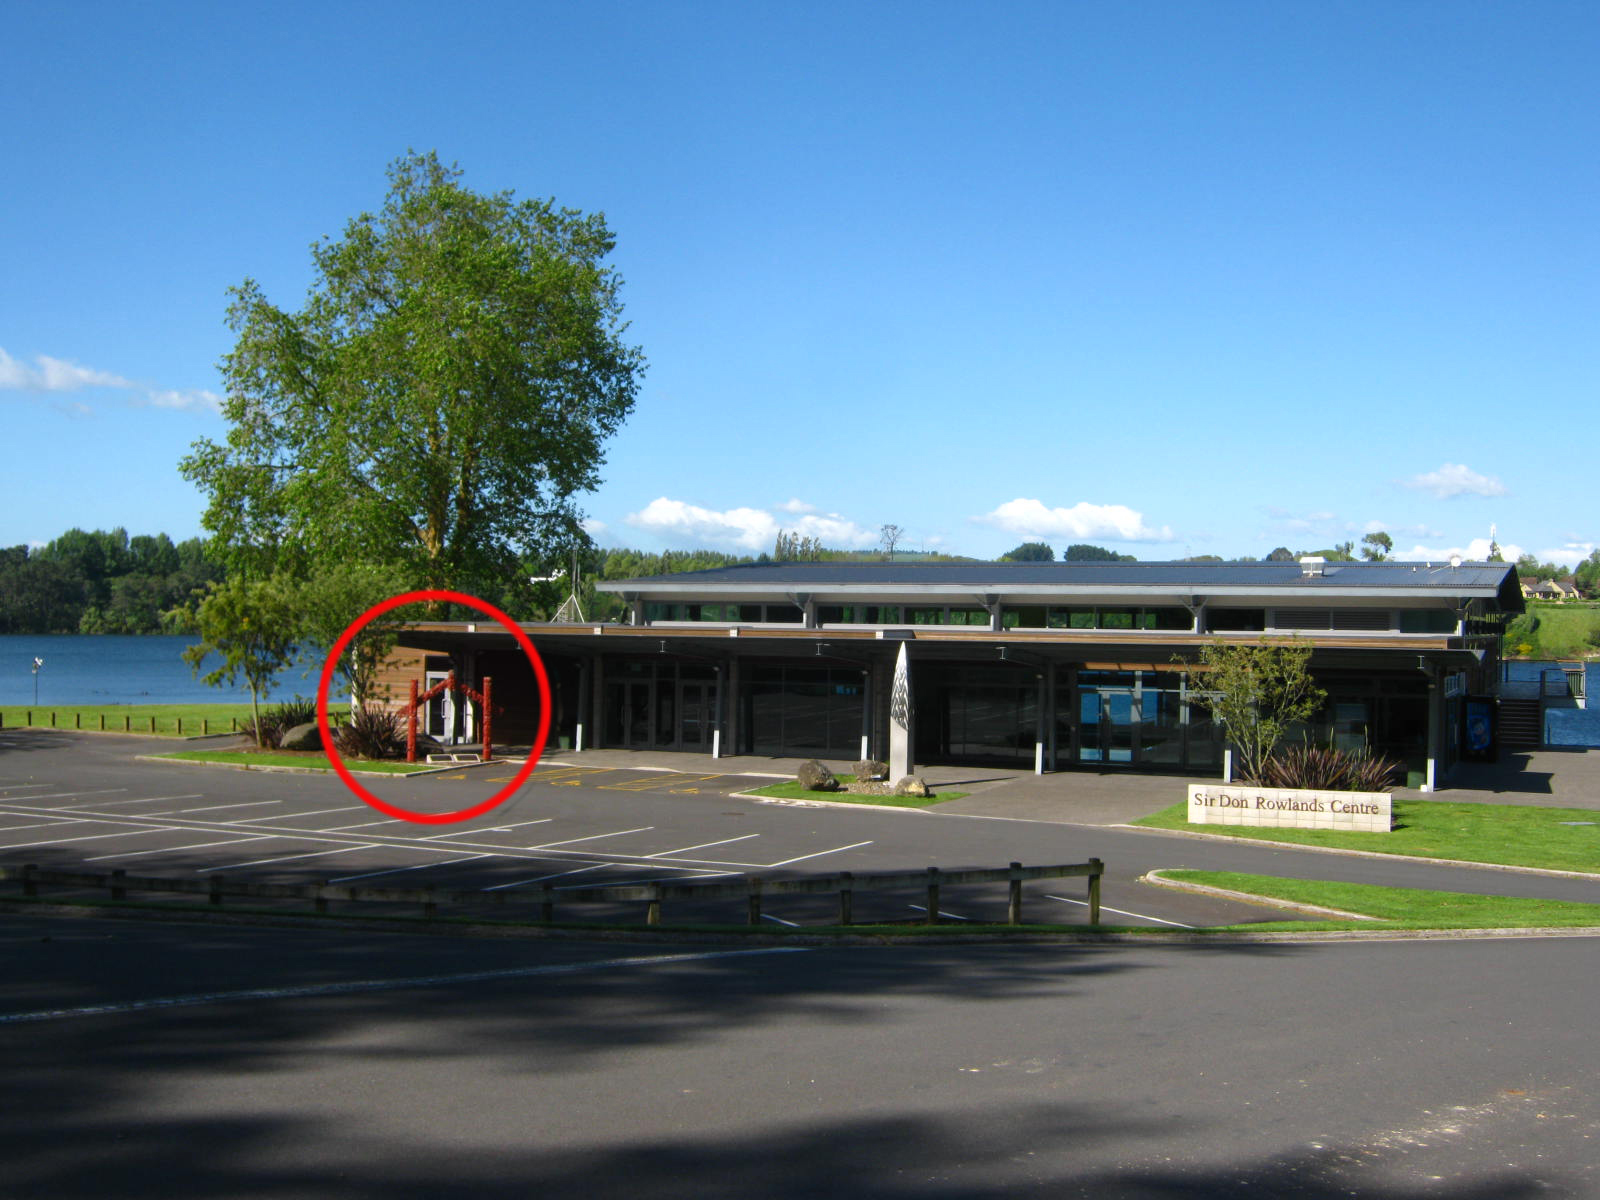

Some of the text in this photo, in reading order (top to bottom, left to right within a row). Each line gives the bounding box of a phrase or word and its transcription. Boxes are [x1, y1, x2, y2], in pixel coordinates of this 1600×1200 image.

[1194, 793, 1379, 815] Sir Don Rowlands Centre
